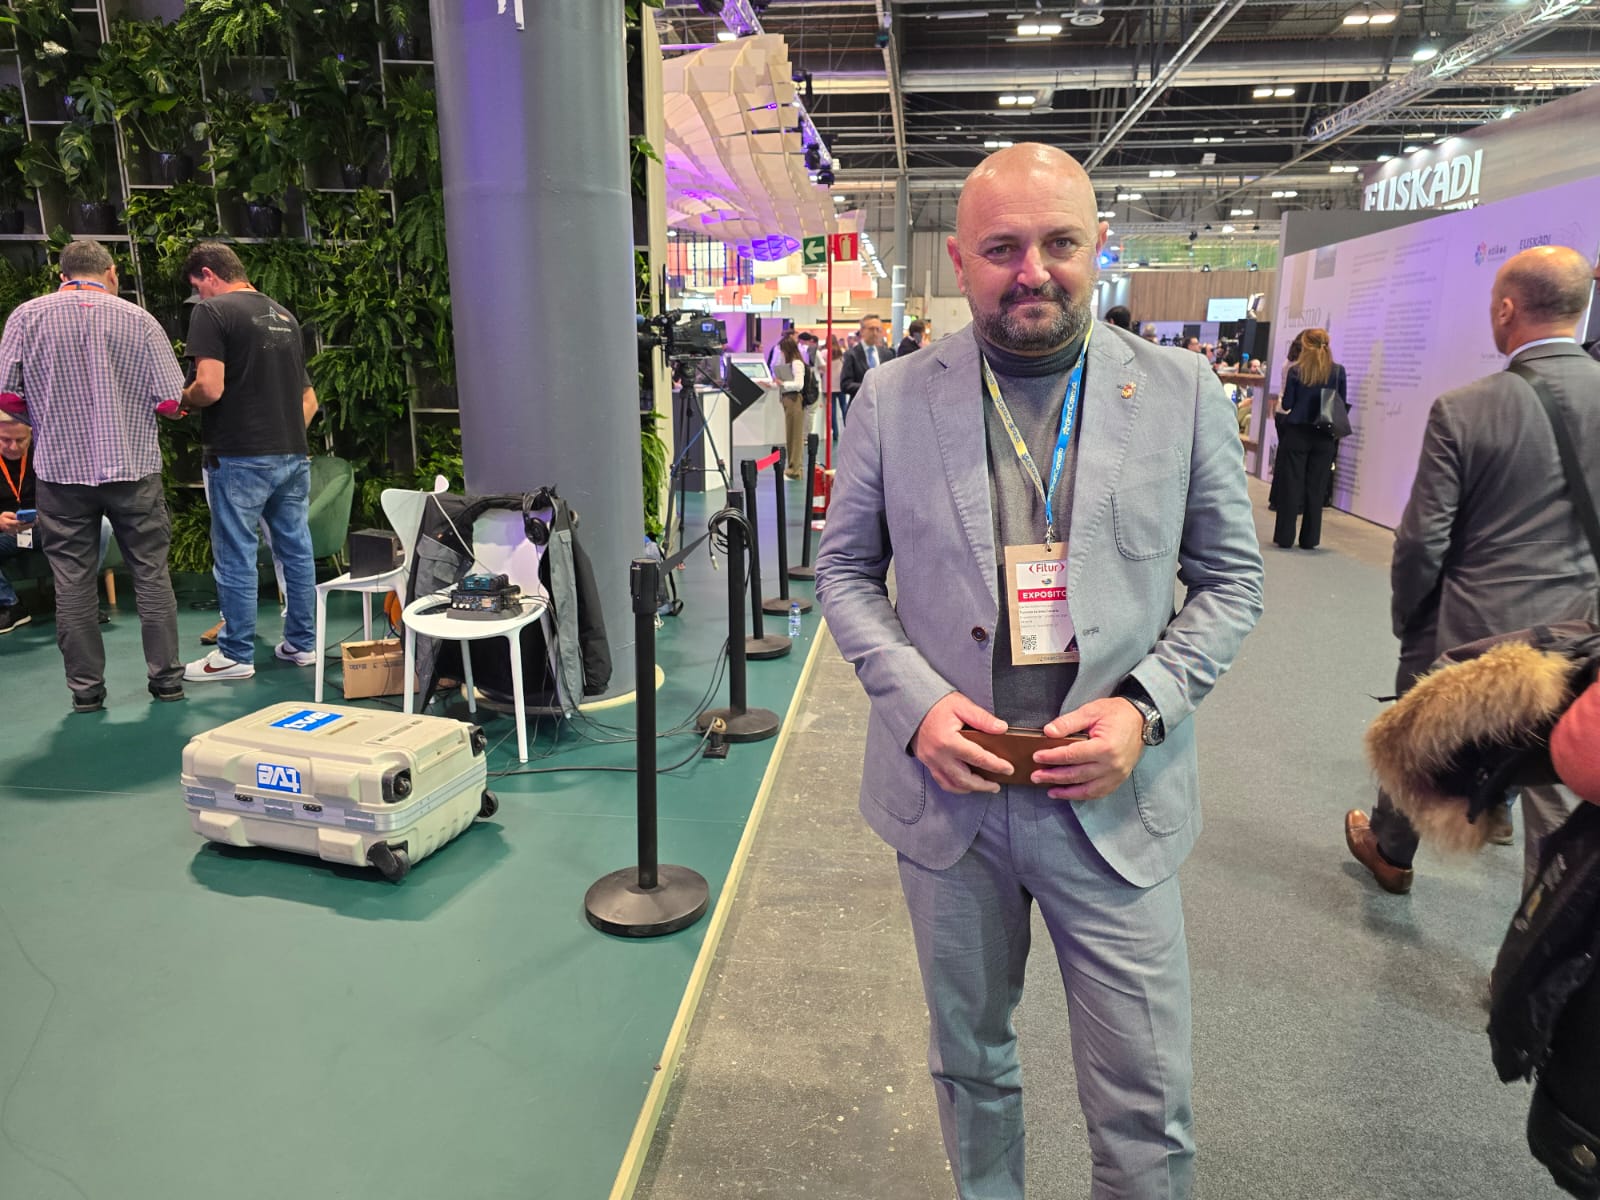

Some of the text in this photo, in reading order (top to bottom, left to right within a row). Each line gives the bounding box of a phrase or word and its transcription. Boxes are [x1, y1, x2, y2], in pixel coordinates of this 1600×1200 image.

[1364, 148, 1483, 212] EUSKADI
[1036, 563, 1059, 573] Fitur
[258, 765, 300, 792] tve
